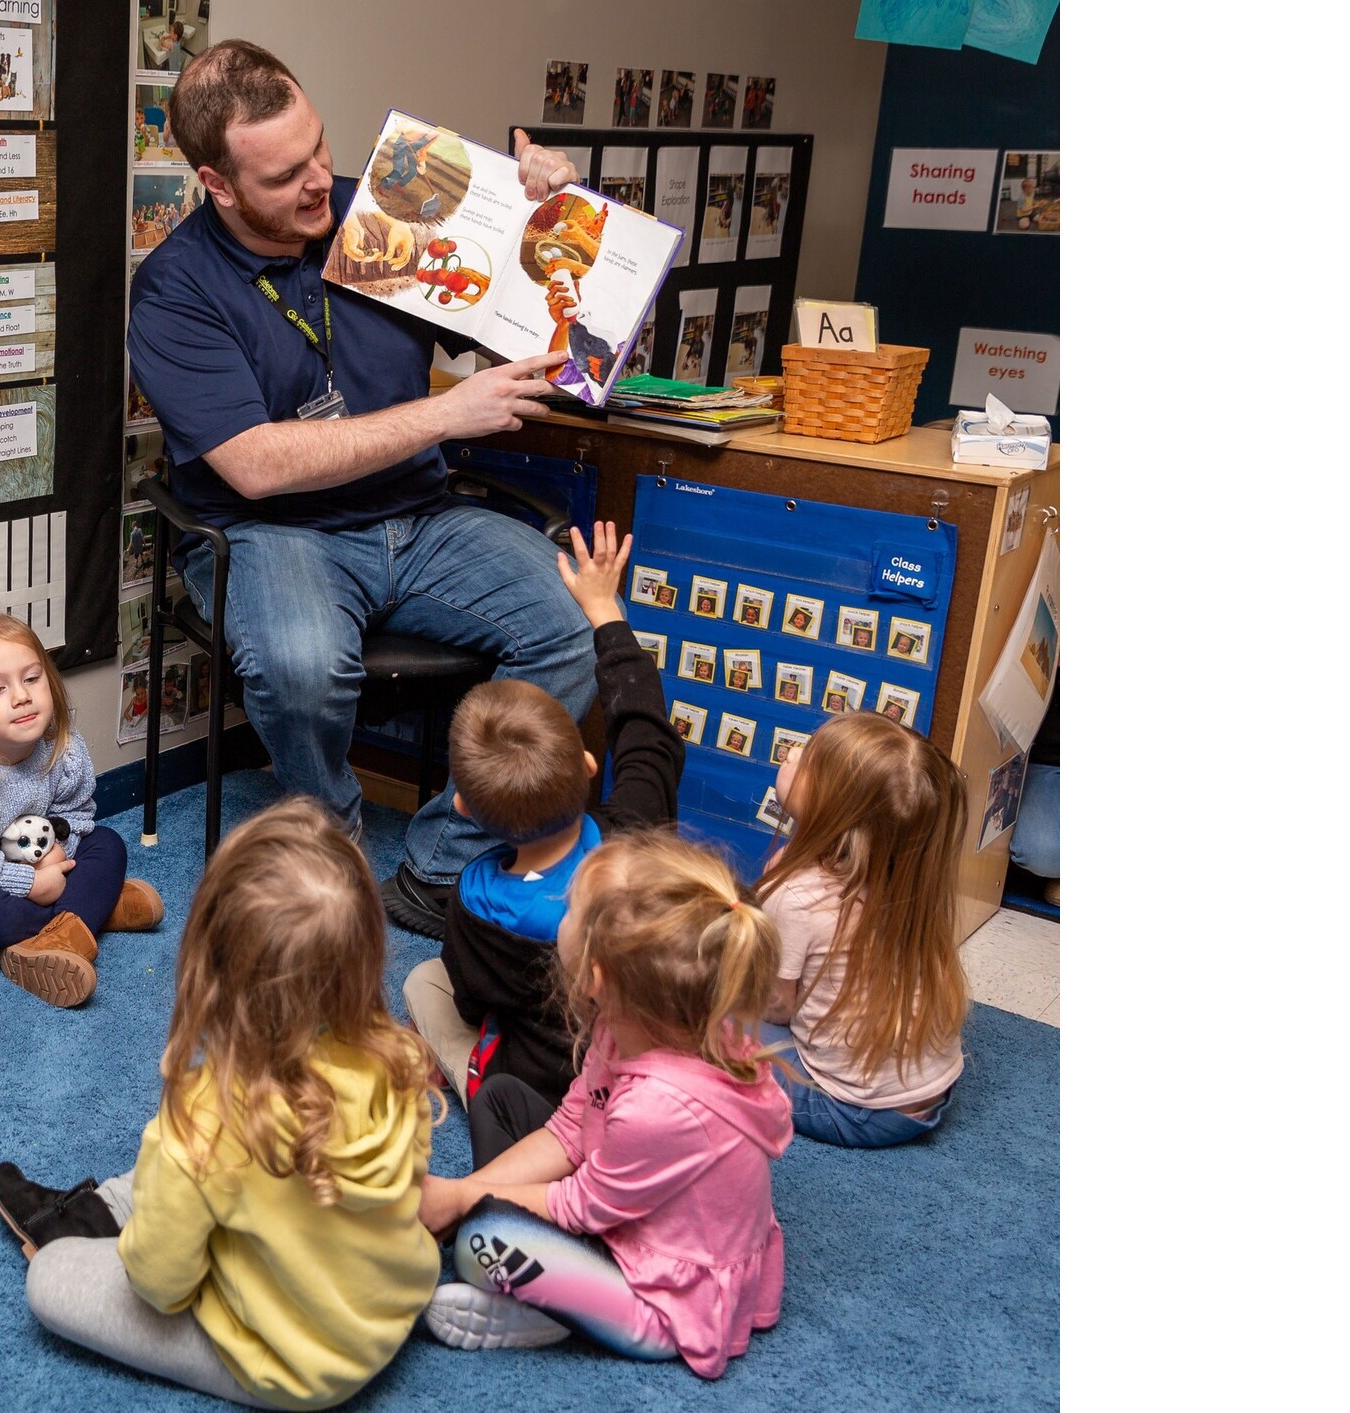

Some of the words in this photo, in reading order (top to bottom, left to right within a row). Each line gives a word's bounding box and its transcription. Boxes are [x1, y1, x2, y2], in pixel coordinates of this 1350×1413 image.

[910, 164, 975, 182] Sharing
[0, 196, 12, 204] and
[912, 188, 966, 205] hands
[6, 324, 20, 332] Float
[818, 312, 854, 344] Aa
[974, 342, 1048, 364] Watching
[8, 360, 22, 369] Truth
[988, 366, 1025, 380] eyes
[17, 446, 32, 454] Lines
[891, 556, 922, 572] Class
[882, 568, 924, 588] Helpers
